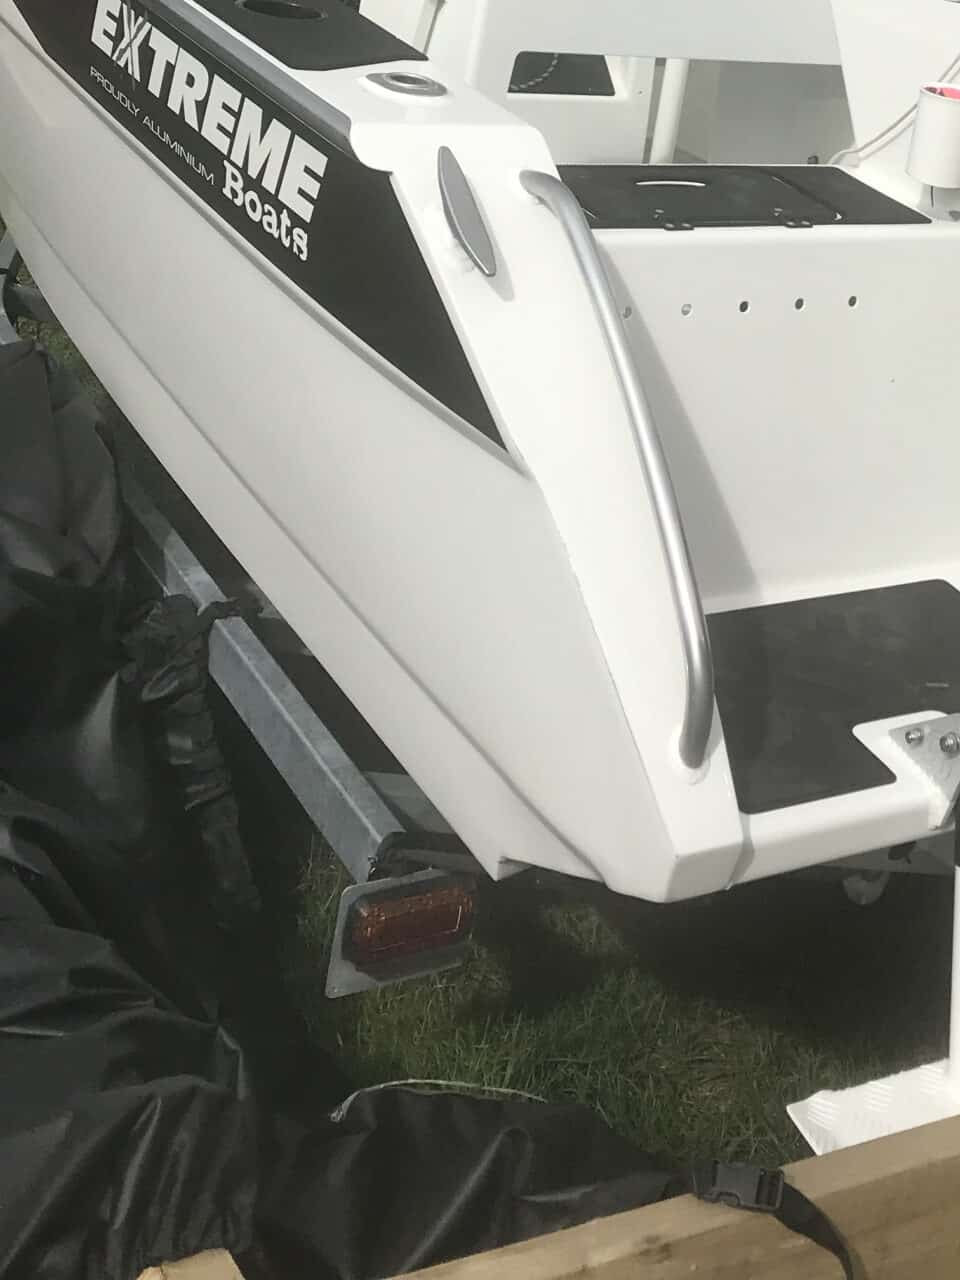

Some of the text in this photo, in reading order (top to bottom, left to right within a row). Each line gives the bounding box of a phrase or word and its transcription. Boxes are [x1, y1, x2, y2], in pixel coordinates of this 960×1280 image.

[89, 65, 216, 186] PROUDLY ALUMINIUM
[221, 159, 310, 262] Boats
